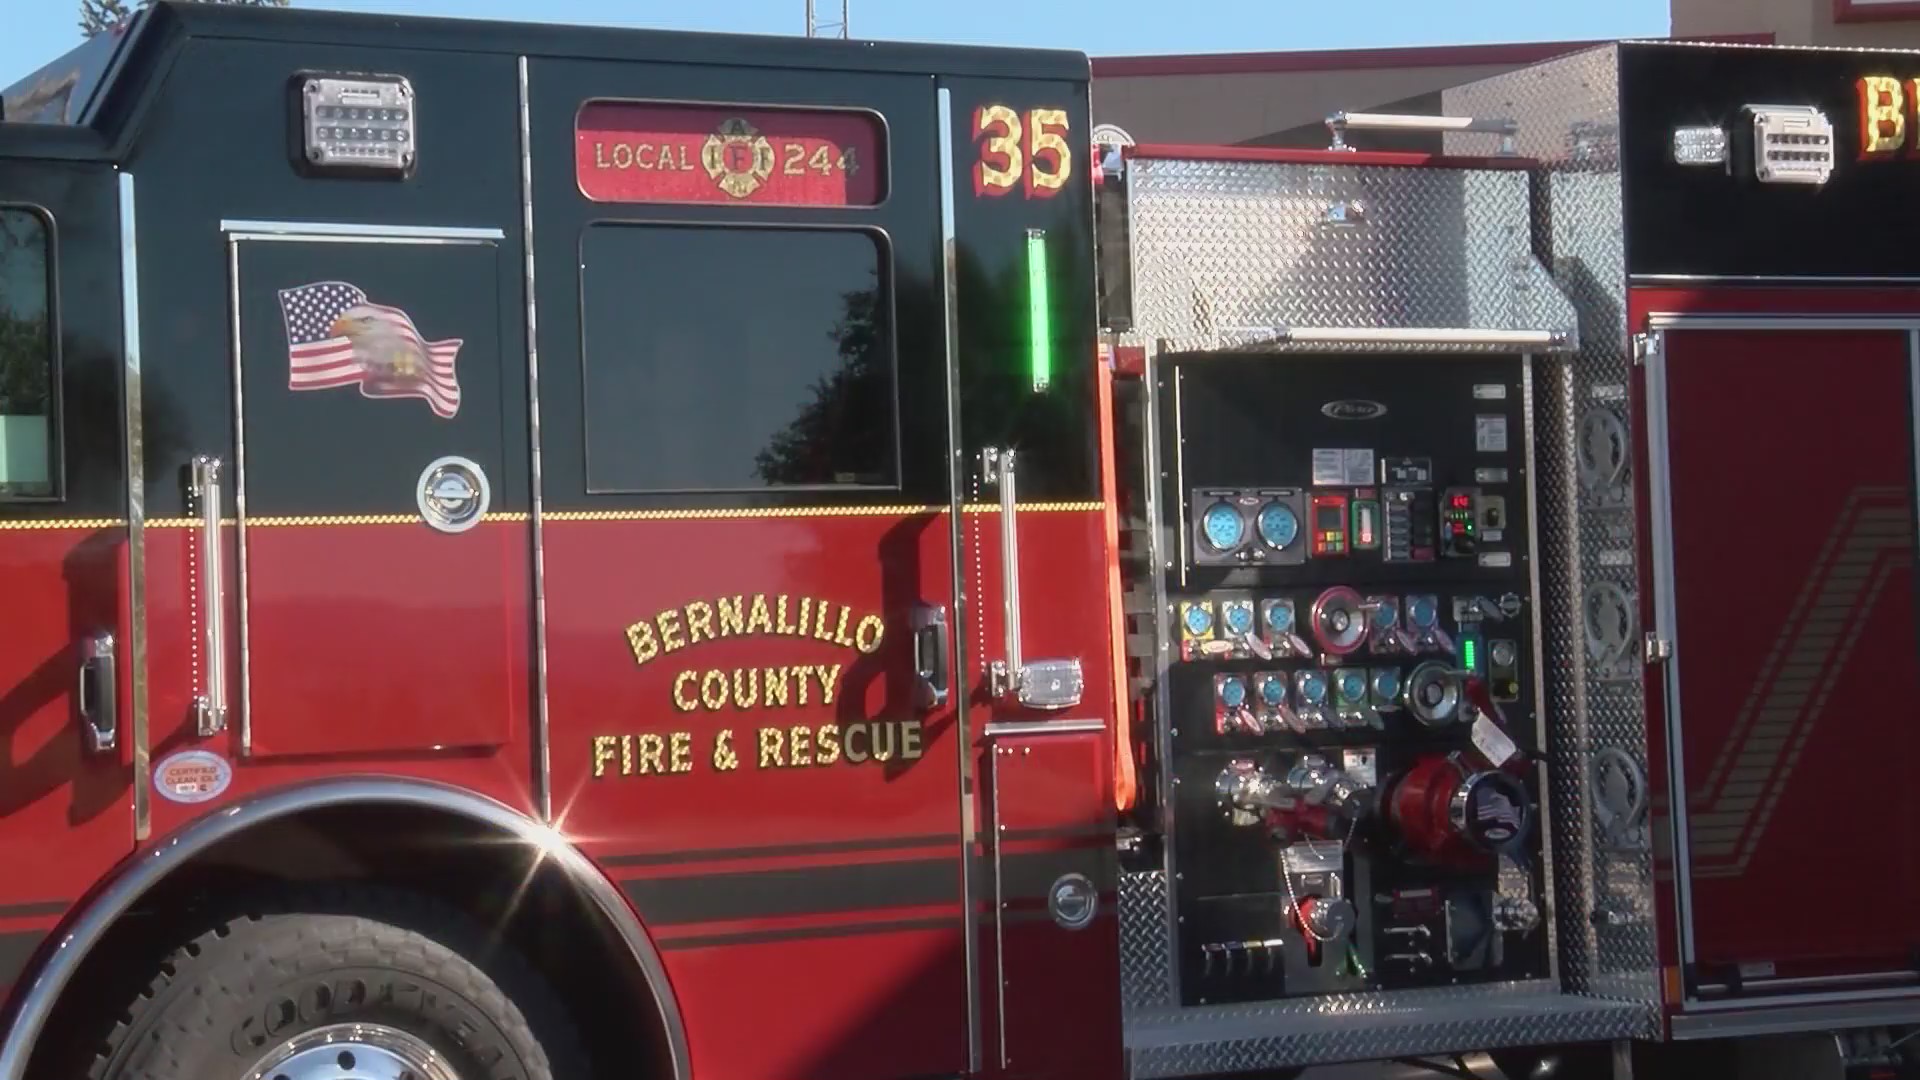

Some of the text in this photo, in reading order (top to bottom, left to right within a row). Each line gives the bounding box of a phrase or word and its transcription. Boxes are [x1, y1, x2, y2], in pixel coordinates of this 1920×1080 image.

[1856, 76, 1920, 160] B
[595, 143, 859, 176] LOCAL 244
[973, 105, 1071, 199] 35
[624, 593, 885, 664] BERNALILLO
[672, 663, 842, 711] COUNTY
[593, 719, 923, 777] FIRE & RESCUE
